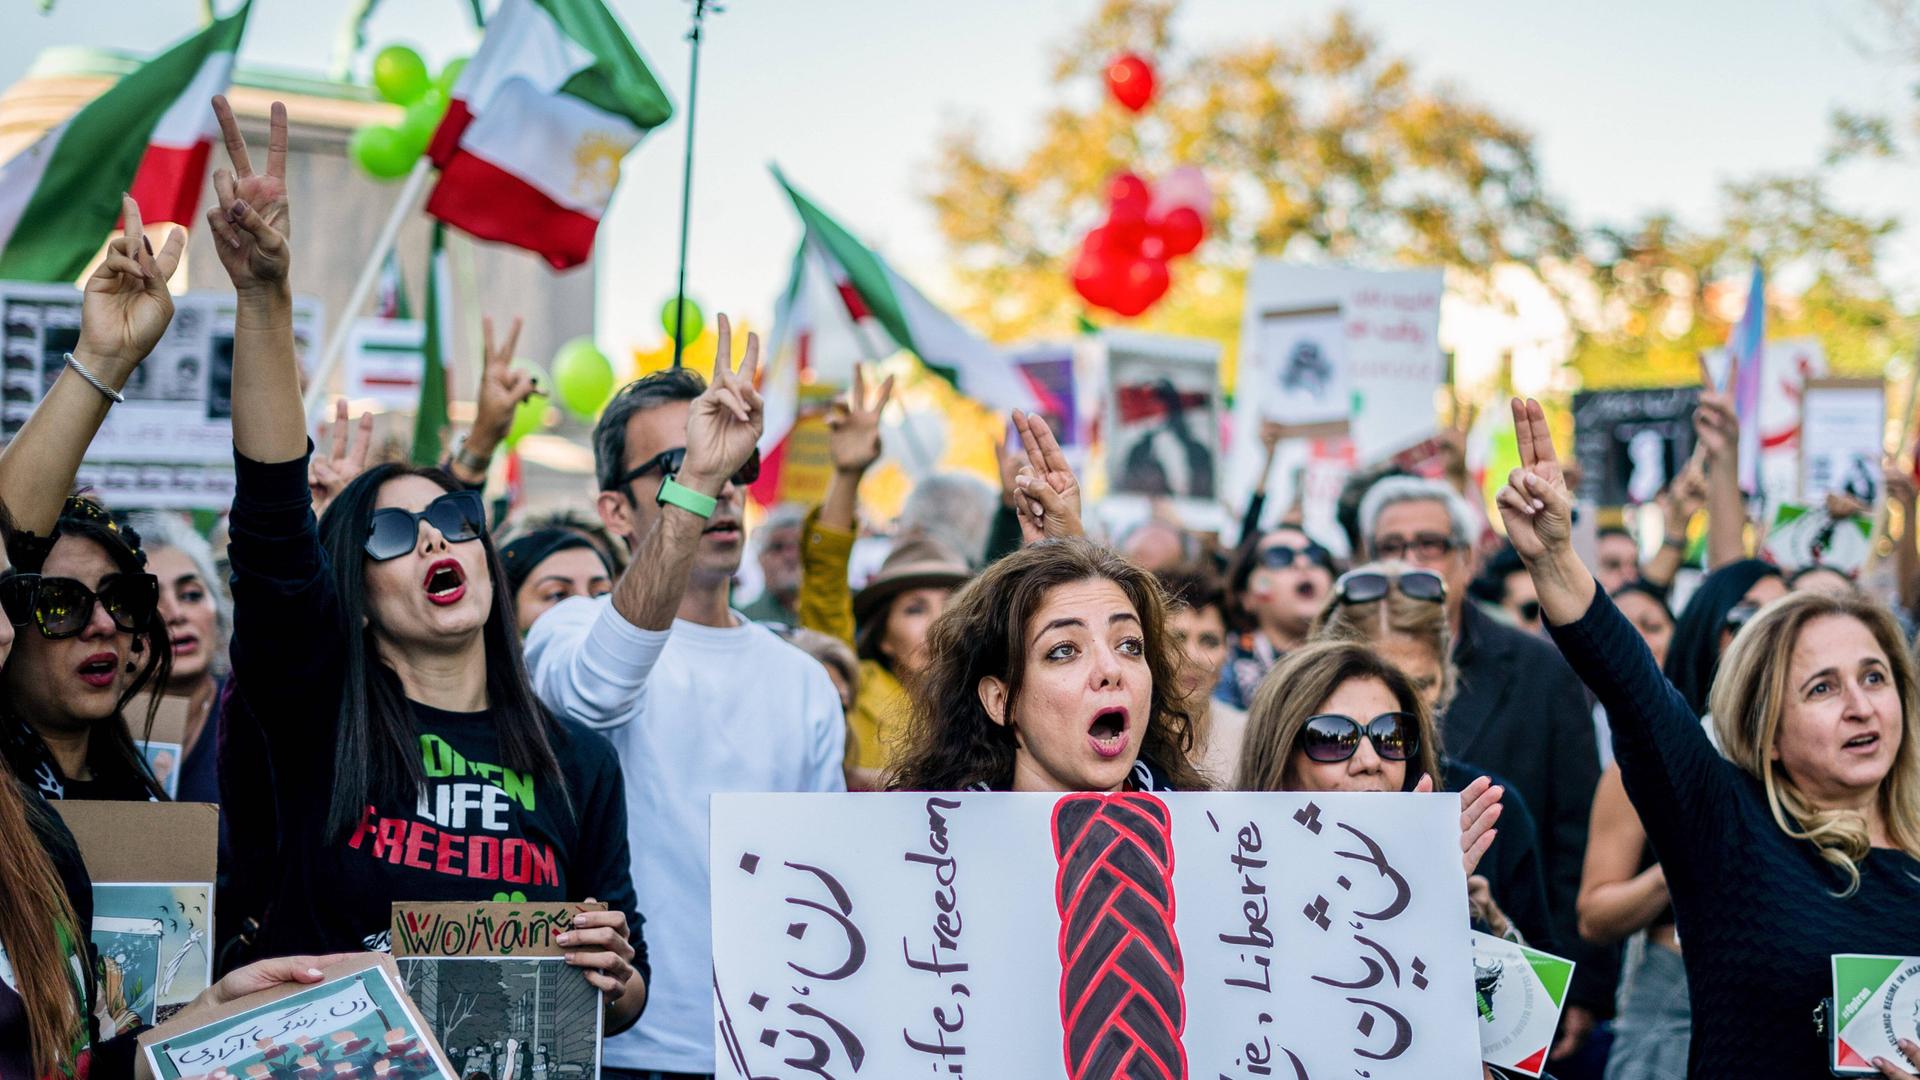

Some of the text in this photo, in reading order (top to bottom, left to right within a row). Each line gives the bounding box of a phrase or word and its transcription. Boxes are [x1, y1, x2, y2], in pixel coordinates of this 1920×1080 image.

[416, 781, 510, 831] LIFE
[348, 804, 559, 888] FREEDOM
[1206, 810, 1274, 1080] ie, Liberté
[1522, 975, 1534, 1009] ISLAMIC
[1883, 982, 1899, 1010] REGIME
[1896, 974, 1906, 984] IN
[1511, 1009, 1533, 1036] REGIME
[1882, 1013, 1898, 1047] ISLAMIC
